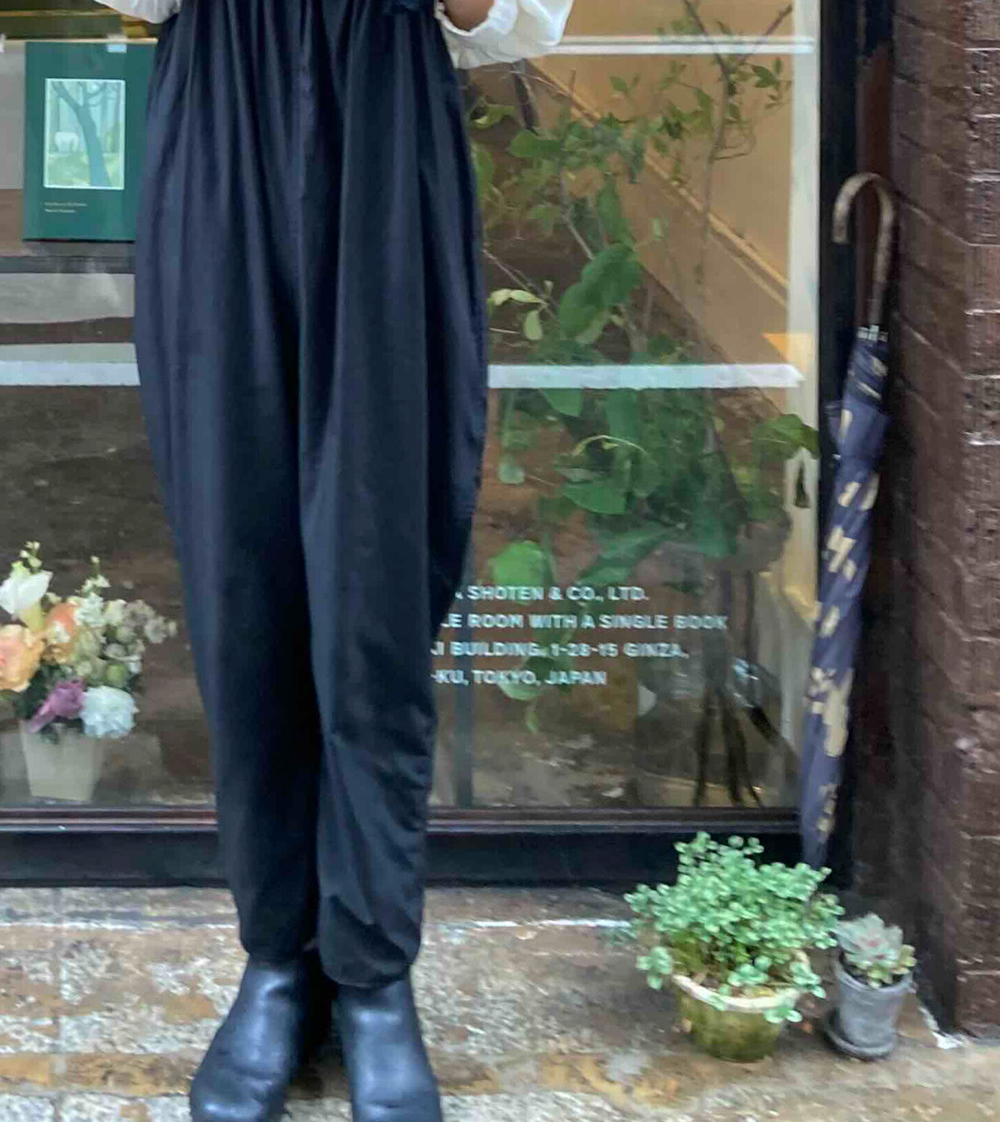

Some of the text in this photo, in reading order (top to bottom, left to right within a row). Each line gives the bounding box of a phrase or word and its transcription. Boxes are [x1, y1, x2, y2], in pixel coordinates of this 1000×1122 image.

[466, 585, 545, 601] SHOTEN
[548, 586, 564, 601] &
[607, 585, 650, 601] LTD.
[466, 613, 524, 628] ROOM
[528, 613, 578, 628] WITH
[580, 614, 596, 629] A
[599, 614, 669, 629] SINGLE
[672, 614, 728, 630] BOOK
[550, 643, 619, 657] 1-28-15
[544, 670, 608, 685] JAPAN
